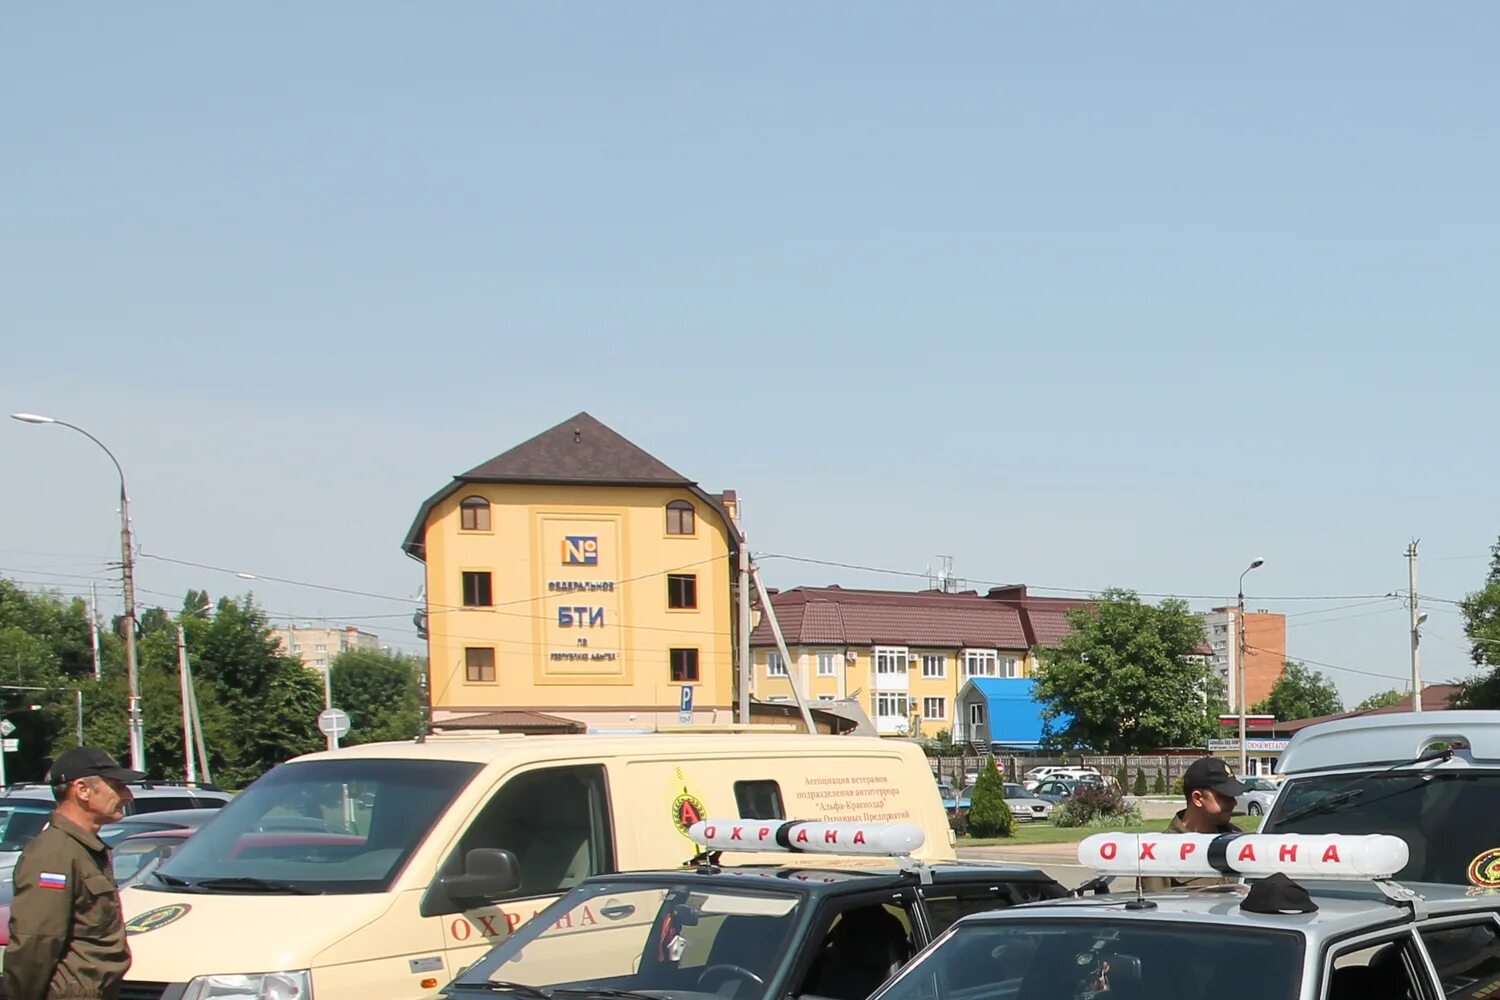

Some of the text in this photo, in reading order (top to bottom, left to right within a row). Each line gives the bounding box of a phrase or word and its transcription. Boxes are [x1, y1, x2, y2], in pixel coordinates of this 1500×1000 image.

[548, 582, 615, 592] ФЕДЕРАЛЬНОЕ
[558, 606, 604, 629] БТИ
[682, 687, 691, 710] P
[704, 826, 866, 844] ОХРАНА
[1099, 842, 1341, 863] ОХРАНА
[450, 904, 598, 941] ОХРНА
